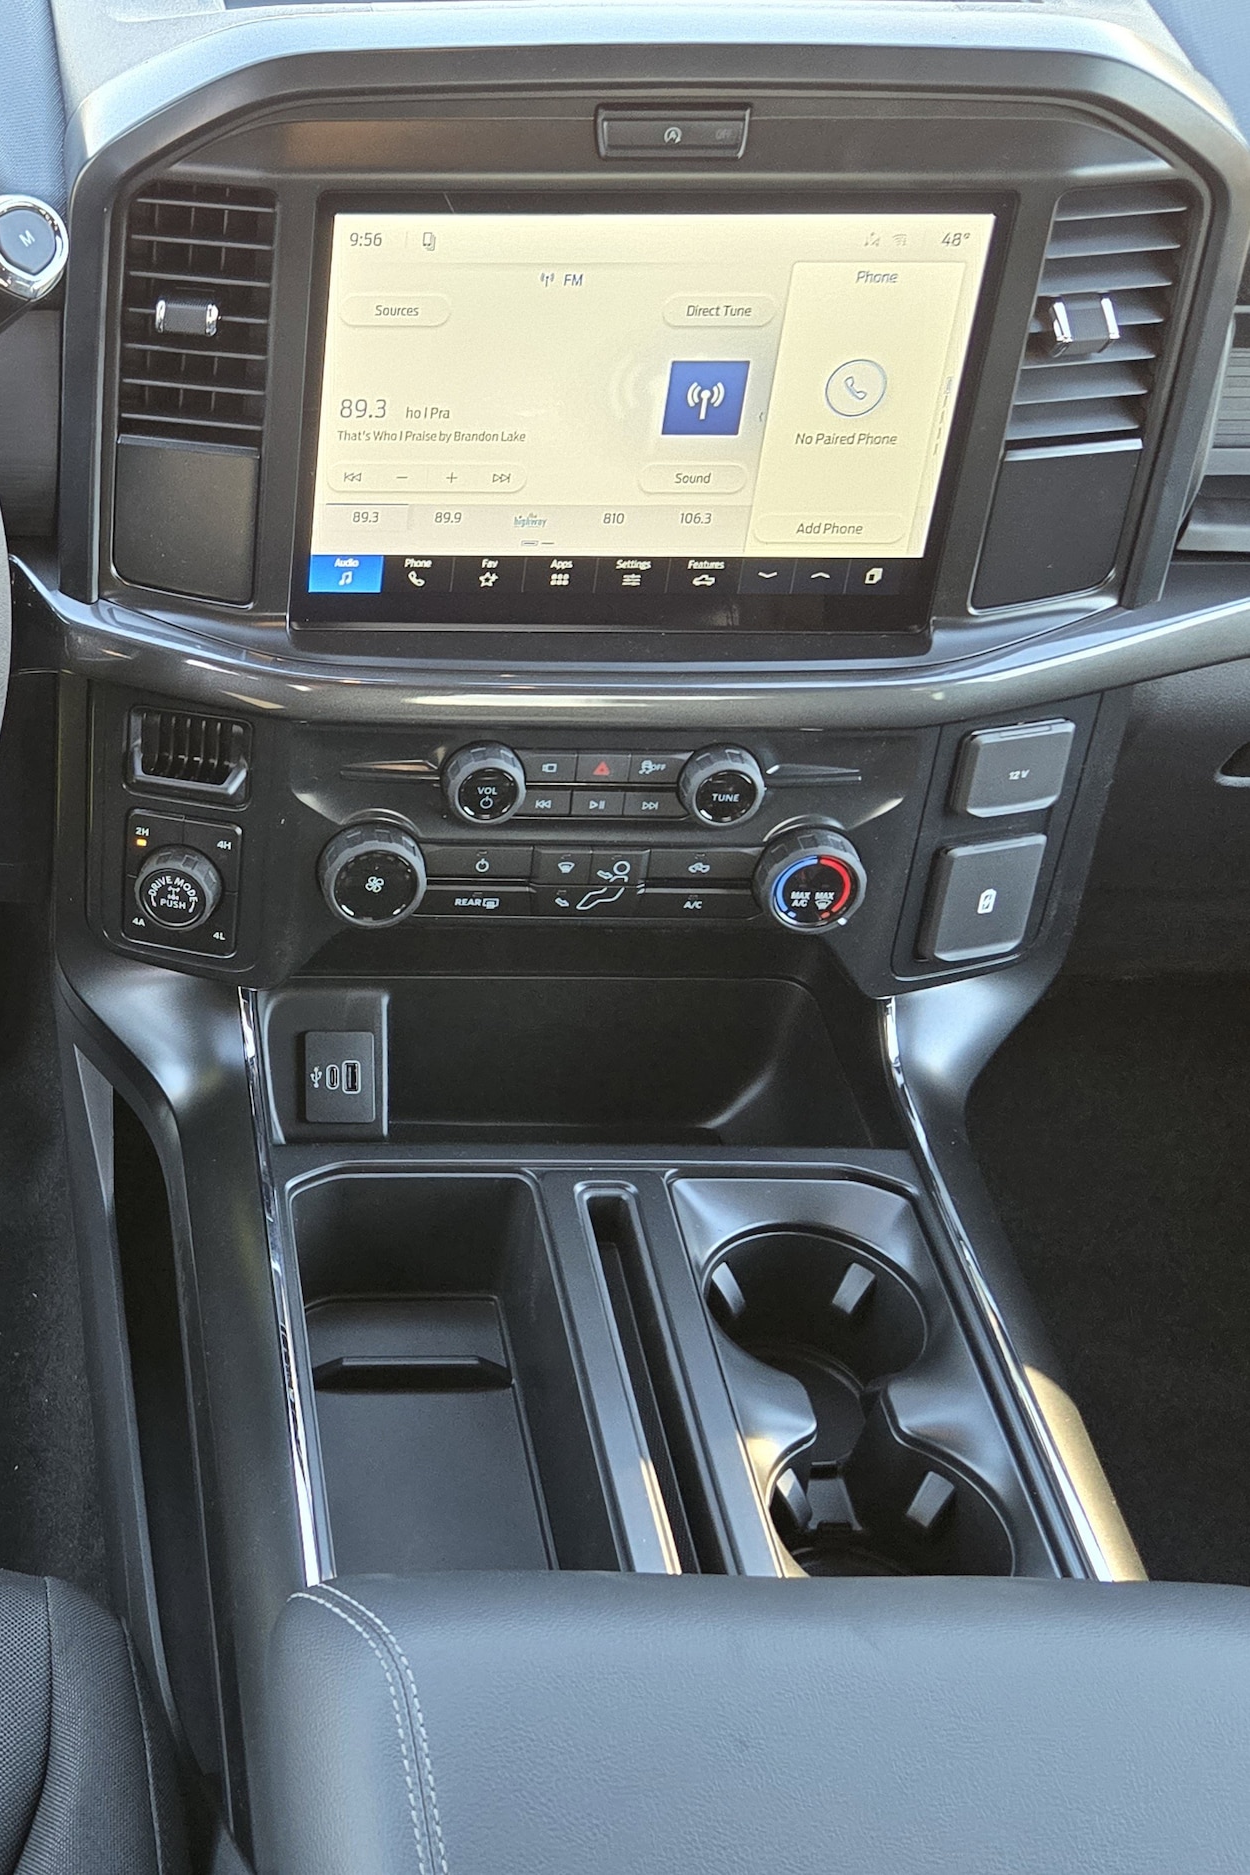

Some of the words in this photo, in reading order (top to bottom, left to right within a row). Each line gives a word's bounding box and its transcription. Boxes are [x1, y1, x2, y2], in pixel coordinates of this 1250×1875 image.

[18, 229, 35, 247] M
[350, 232, 383, 247] 9:56
[563, 273, 584, 287] FM
[855, 270, 898, 284] Phone
[374, 304, 420, 317] Sources
[686, 304, 720, 317] Direct
[723, 304, 752, 317] Tune
[340, 398, 387, 419] 89.3
[337, 430, 371, 442] That's
[373, 430, 397, 442] Who
[404, 430, 437, 442] Praise
[438, 430, 452, 444] by
[453, 430, 499, 443] Brandon
[500, 431, 526, 443] Lake
[795, 433, 812, 445] No
[815, 432, 855, 445] Paired
[856, 432, 898, 446] Phone
[674, 472, 712, 484] Sound
[352, 511, 380, 524] 89.3
[434, 511, 463, 524] 89.9
[603, 512, 625, 525] 810
[680, 512, 713, 525] 106.3
[796, 523, 820, 535] Add
[822, 523, 864, 535] Phone
[334, 558, 360, 569] Audio
[404, 558, 433, 569] Phone
[481, 558, 499, 570] Fav
[550, 558, 573, 571] Apps
[615, 558, 652, 571] Settings
[687, 559, 725, 571] Features
[477, 786, 498, 796] VOL
[712, 792, 740, 803] TUNE
[135, 827, 149, 837] 2H
[217, 840, 232, 850] 4H
[148, 875, 173, 897] DRIVE
[173, 877, 198, 903] MODE
[790, 891, 811, 900] MAX
[814, 891, 835, 900] MAX
[160, 898, 186, 910] PUSH
[454, 897, 482, 907] REAR
[683, 900, 703, 910] A/C
[791, 899, 808, 908] A/C
[132, 917, 146, 927] 4A
[212, 931, 226, 941] 4L
